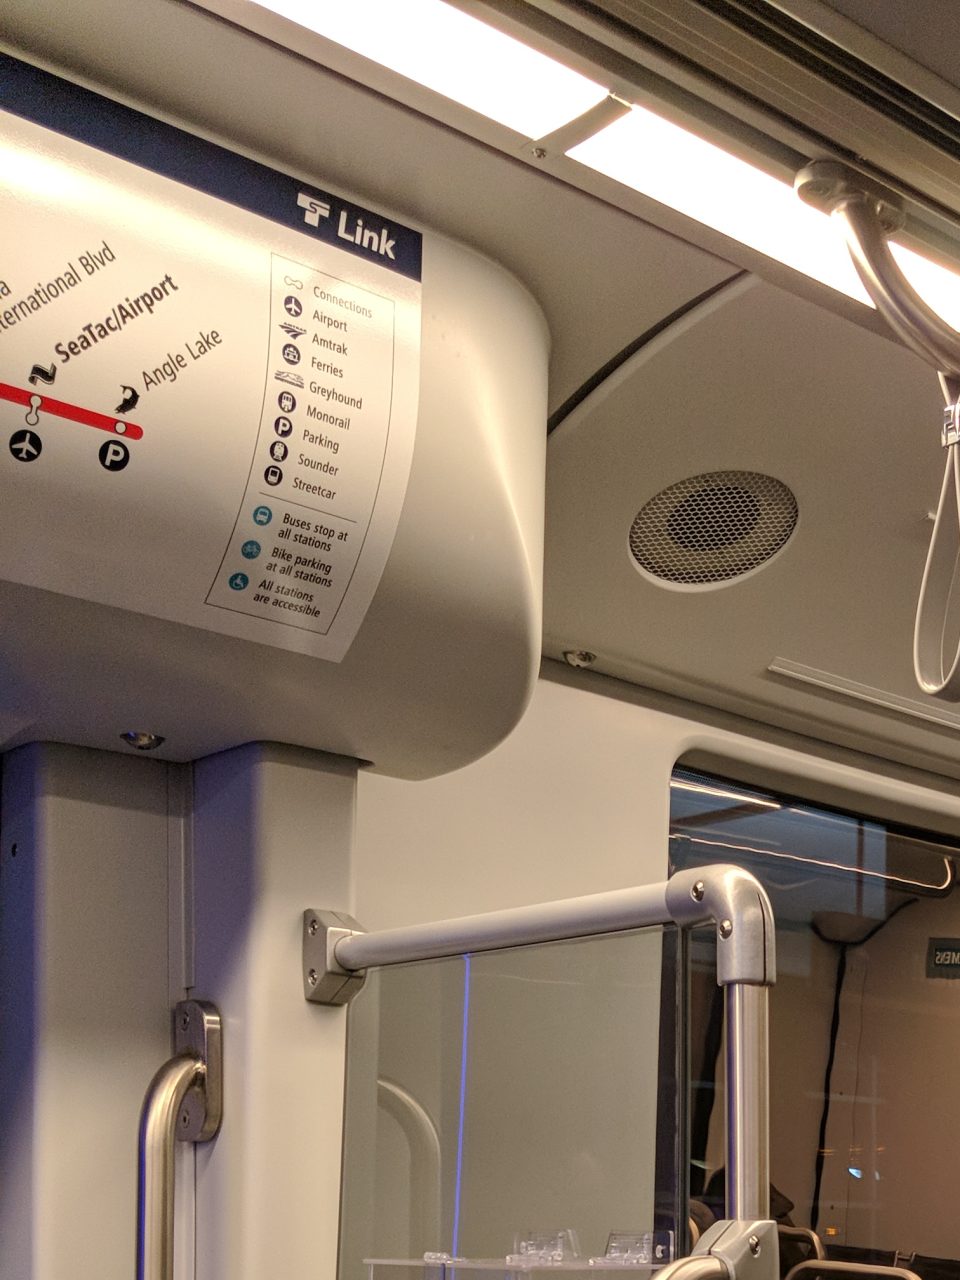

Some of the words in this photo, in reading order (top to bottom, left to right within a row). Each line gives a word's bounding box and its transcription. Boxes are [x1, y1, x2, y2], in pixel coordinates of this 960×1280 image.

[338, 210, 396, 260] Link
[0, 262, 82, 332] ternational
[78, 240, 116, 276] Blvd
[313, 286, 373, 319] Connections
[55, 273, 179, 364] SeaTac/Airport
[312, 309, 348, 333] Airport
[312, 333, 348, 356] Amtrak
[142, 353, 188, 392] Angle
[185, 328, 223, 361] Lake
[311, 356, 344, 378] Ferries
[309, 381, 363, 410] Greyhound
[306, 404, 351, 430] Monorail
[302, 429, 340, 454] Parking
[298, 453, 339, 476] Sounder
[292, 477, 337, 501] Streetcar
[282, 512, 311, 531] Buses
[314, 522, 335, 540] stop
[337, 530, 348, 542] at
[278, 529, 291, 541] all
[293, 532, 332, 552] stations
[271, 546, 293, 563] Bike
[294, 555, 332, 576] parking
[265, 561, 278, 572] at
[279, 564, 293, 577] all
[294, 569, 333, 588] stations
[258, 579, 273, 592] All
[274, 584, 314, 603] stations
[253, 592, 270, 604] are
[271, 597, 321, 618] accessible
